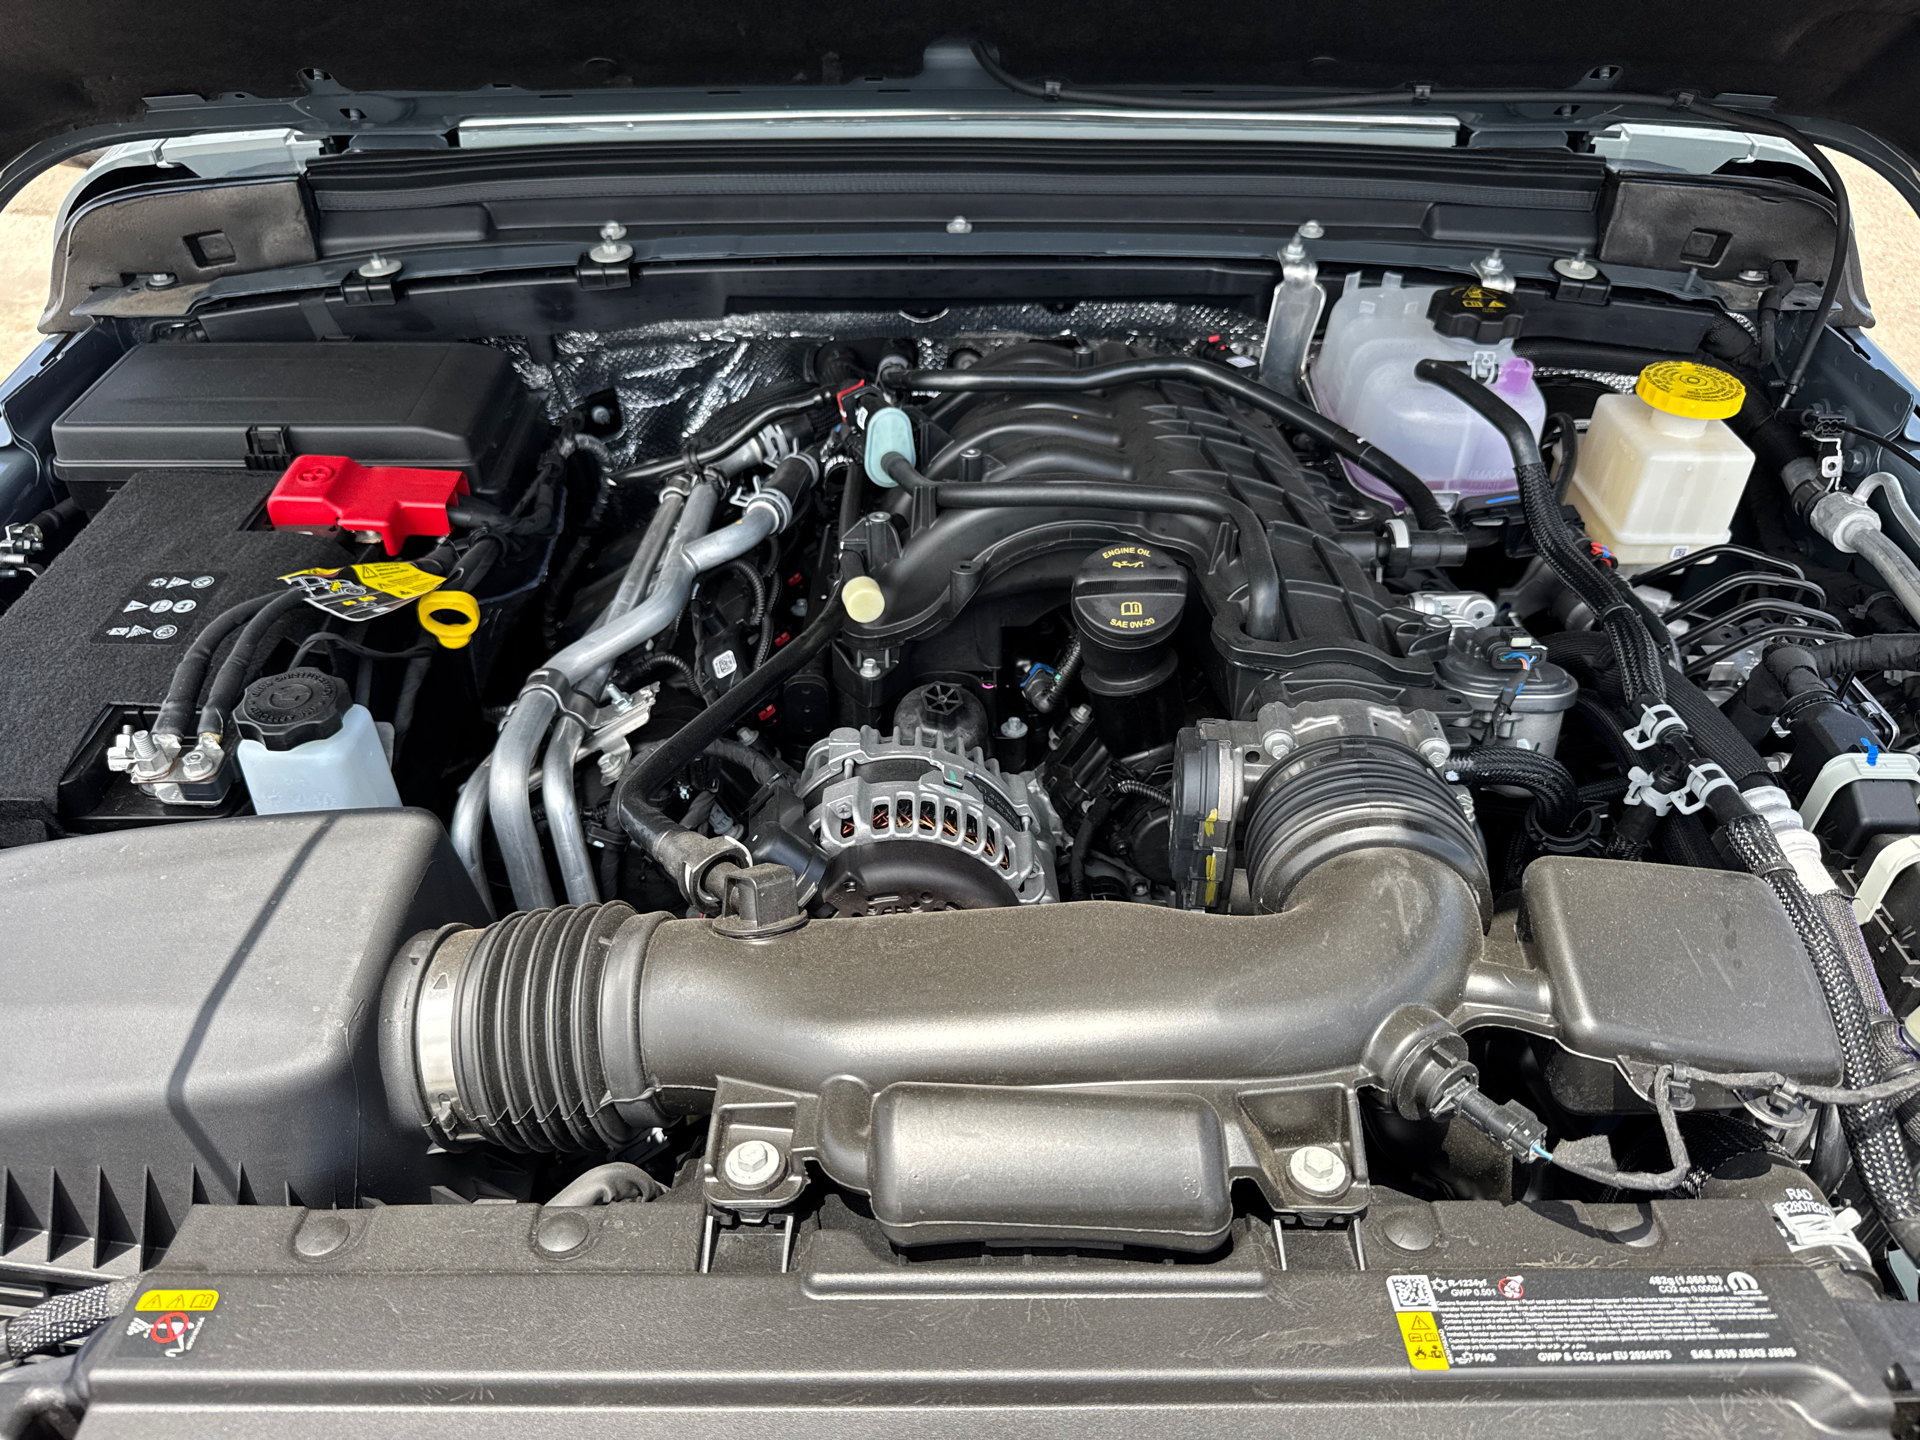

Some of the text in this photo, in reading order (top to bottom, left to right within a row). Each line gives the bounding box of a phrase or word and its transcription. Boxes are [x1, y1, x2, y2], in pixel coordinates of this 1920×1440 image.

[1102, 547, 1151, 558] ENGINE OIL
[1110, 617, 1155, 628] SAE 0W-20
[1785, 1188, 1813, 1201] RAD
[1451, 1289, 1496, 1297] GWP 0.501
[1659, 1285, 1678, 1294] CO2
[1474, 1353, 1497, 1362] PAG
[1537, 1352, 1562, 1362] GWP
[1573, 1351, 1595, 1362] CO2
[1612, 1350, 1628, 1360] EU
[1690, 1349, 1713, 1360] SAE
